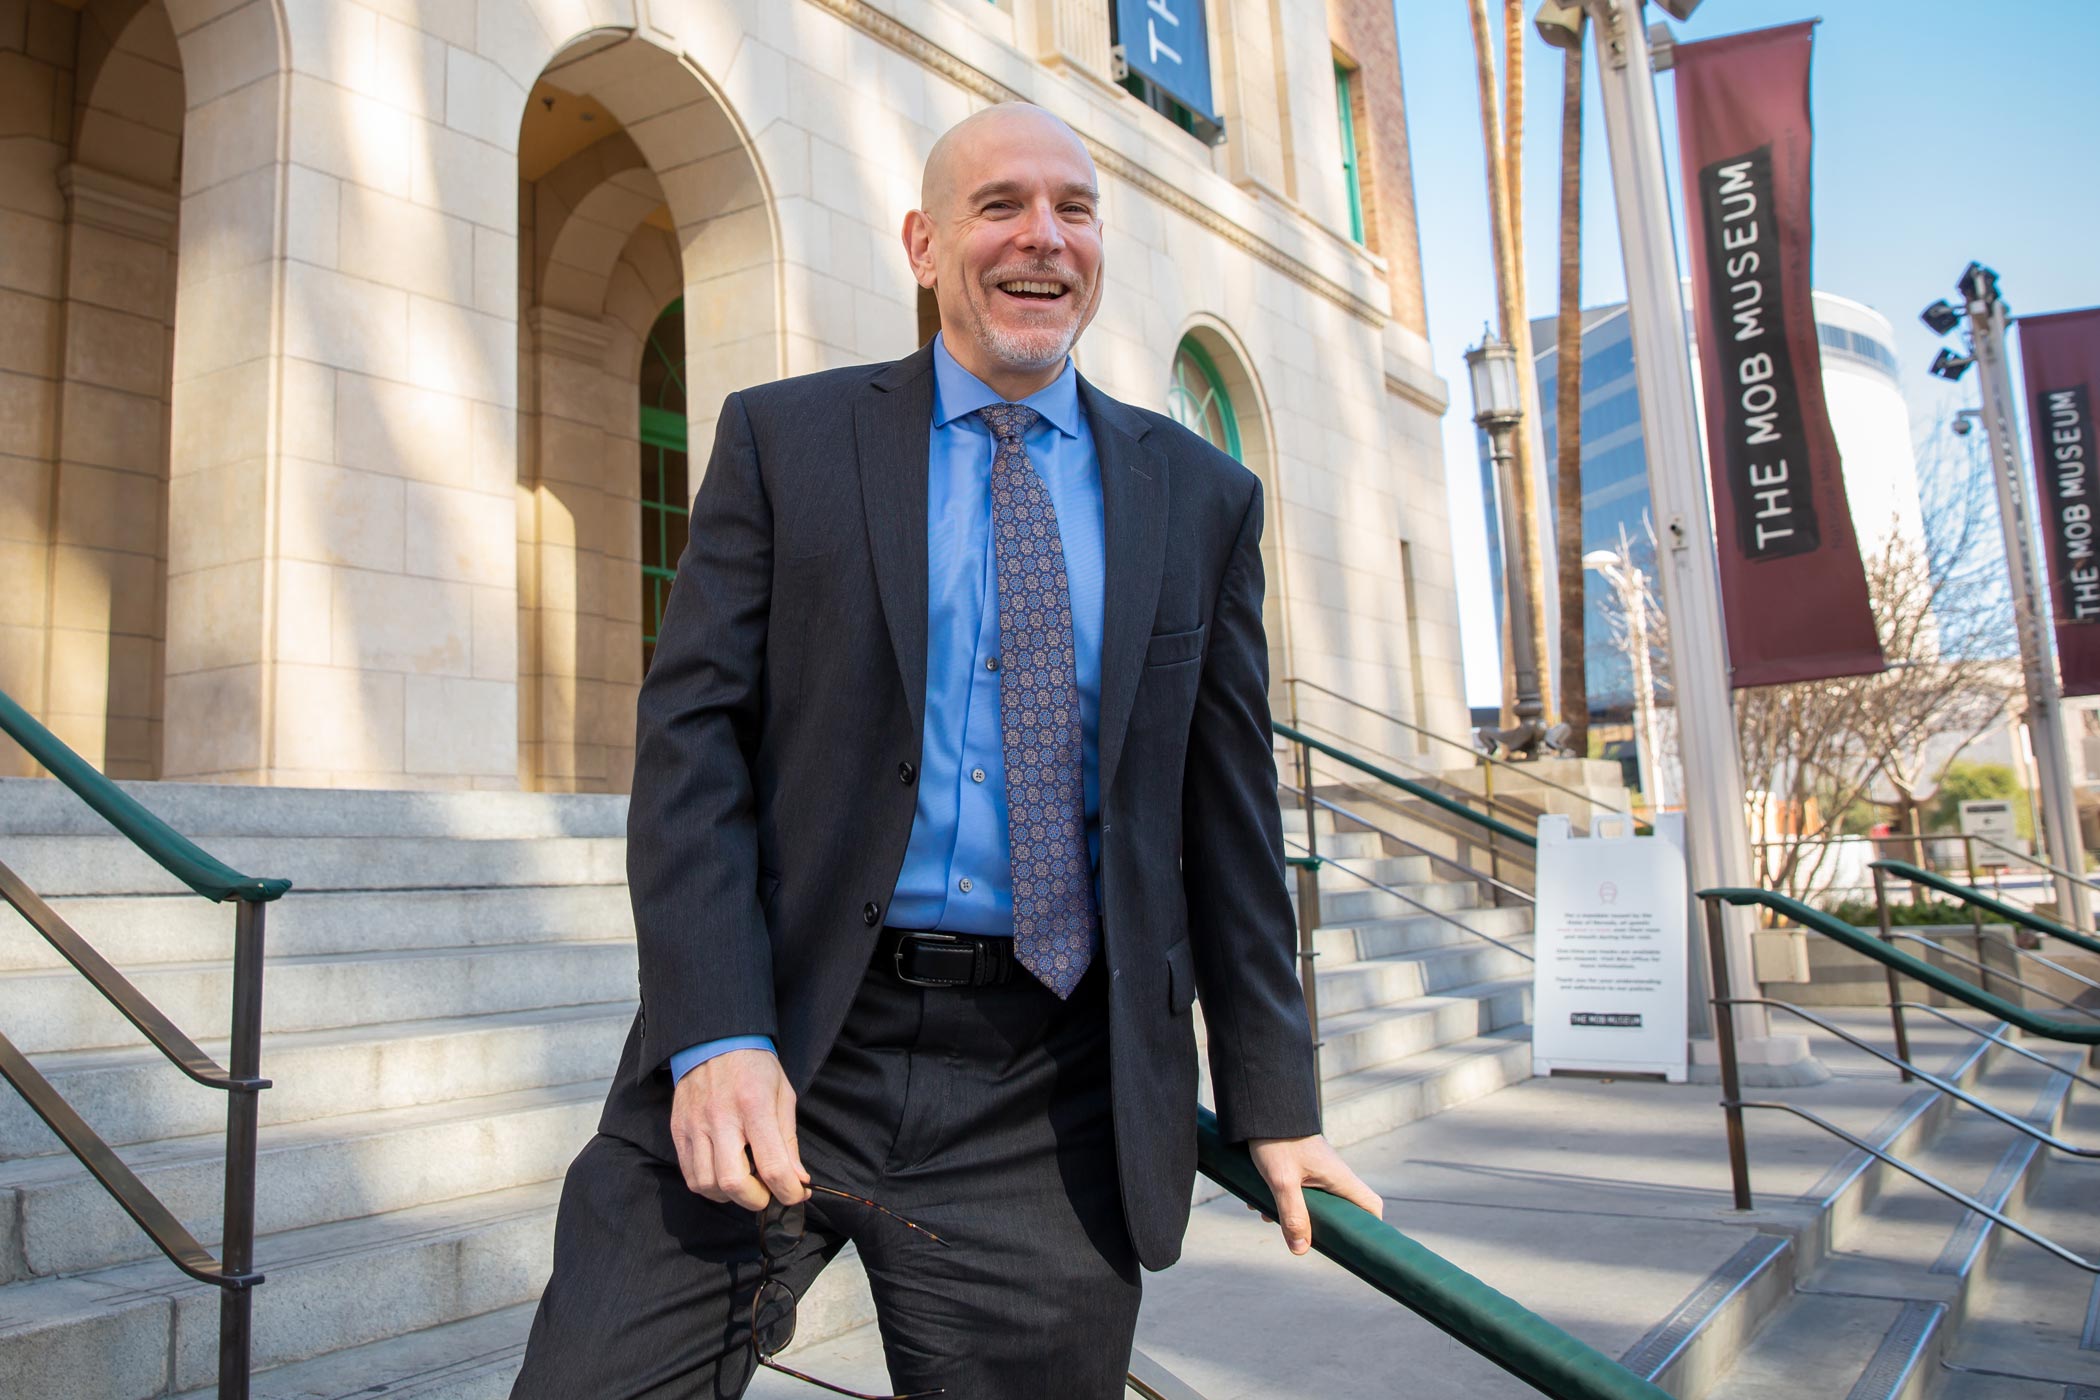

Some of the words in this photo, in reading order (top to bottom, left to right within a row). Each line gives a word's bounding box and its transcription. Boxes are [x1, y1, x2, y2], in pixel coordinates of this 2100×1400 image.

[1717, 160, 1765, 341] MUSEUM
[1739, 352, 1782, 445] MOB
[2049, 390, 2086, 498] MUSEUM
[1749, 459, 1794, 550] THE
[2062, 503, 2094, 560] MOB
[2069, 566, 2100, 621] THE
